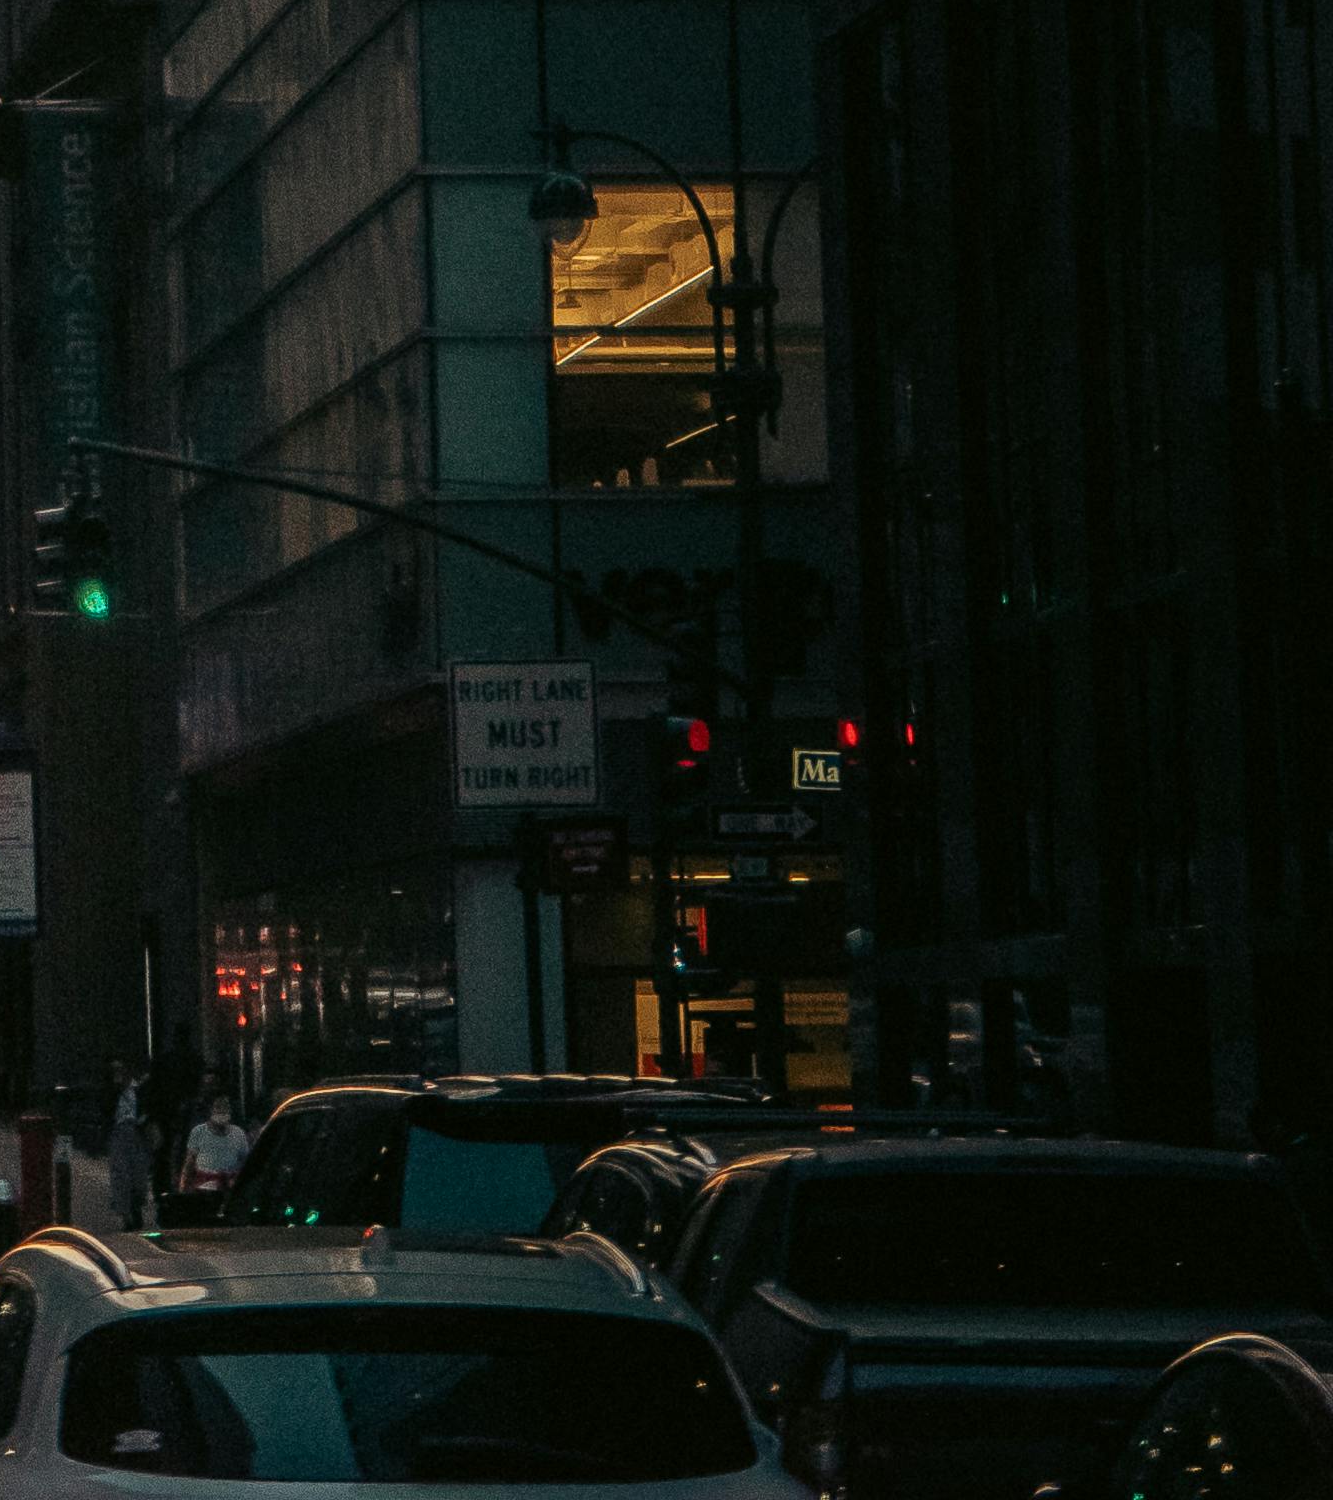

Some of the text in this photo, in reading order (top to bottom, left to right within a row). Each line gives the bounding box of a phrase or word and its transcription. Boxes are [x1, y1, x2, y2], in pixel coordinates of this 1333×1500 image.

[52, 132, 96, 297] Science
[459, 678, 588, 702] RIGHT LANE
[487, 720, 562, 749] MUST
[461, 764, 592, 789] TURN RIGHT
